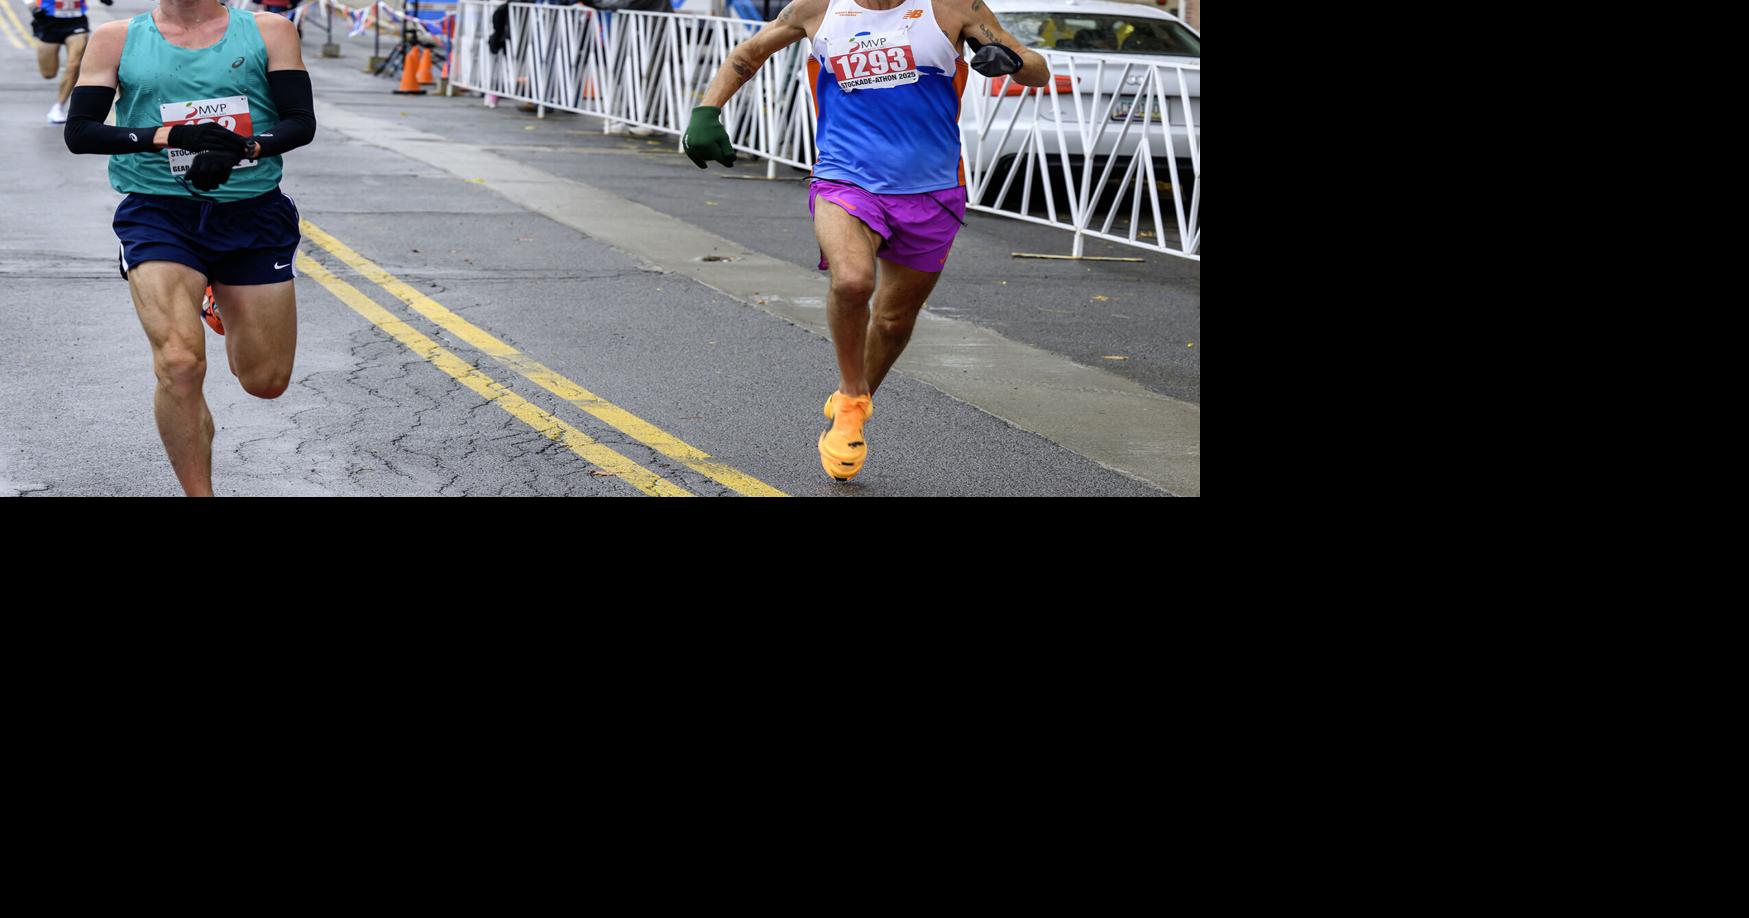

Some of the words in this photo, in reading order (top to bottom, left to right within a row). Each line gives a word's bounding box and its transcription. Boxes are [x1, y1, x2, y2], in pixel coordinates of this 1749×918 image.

[861, 37, 887, 49] MVP
[836, 47, 908, 79] 1293
[841, 74, 897, 88] STOCKADE-ATHON
[898, 71, 916, 80] 2025
[198, 103, 227, 115] MVP
